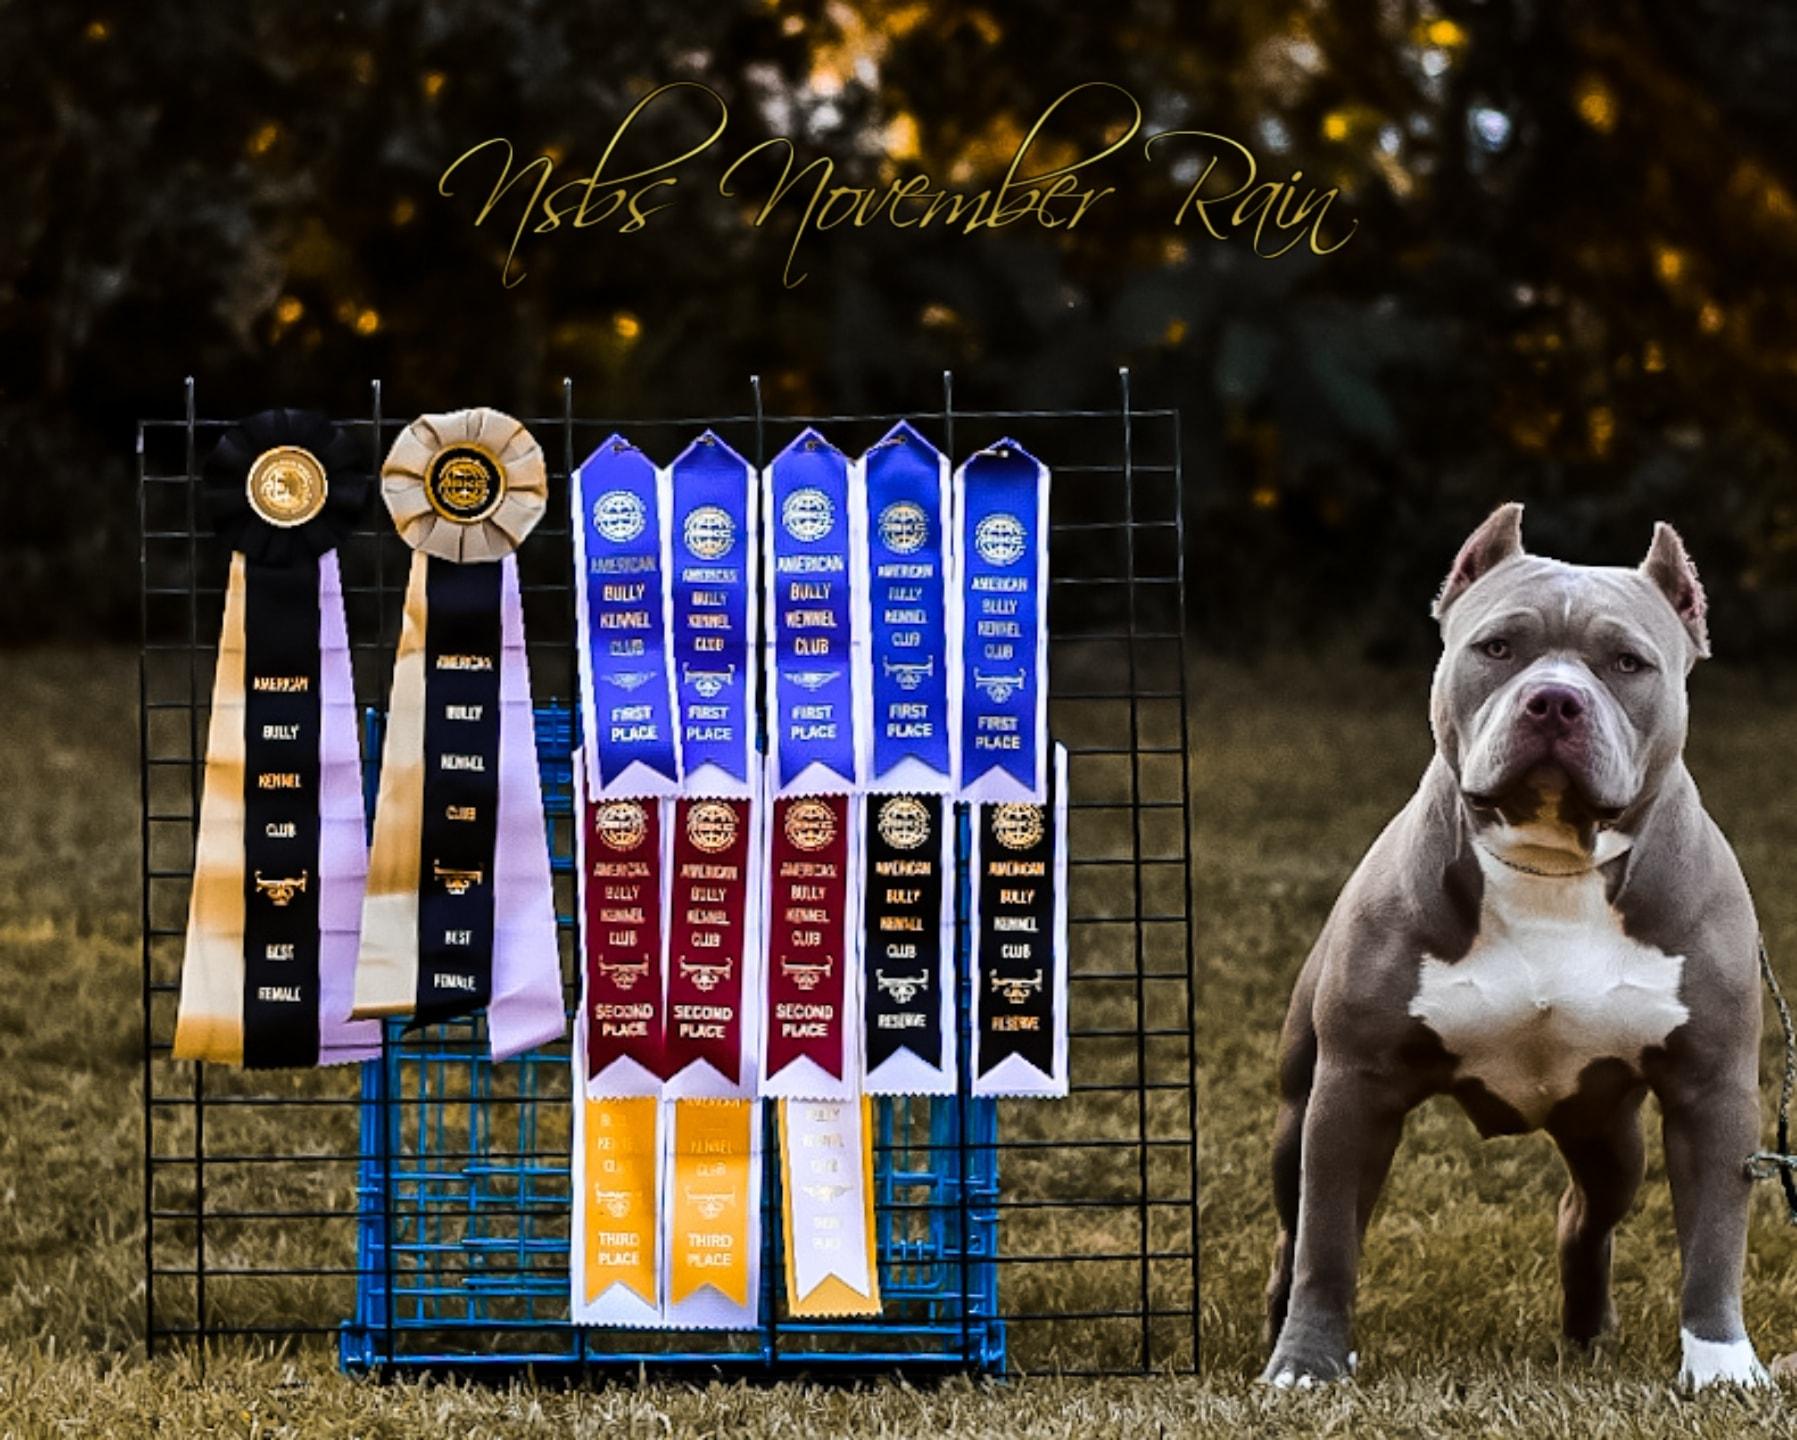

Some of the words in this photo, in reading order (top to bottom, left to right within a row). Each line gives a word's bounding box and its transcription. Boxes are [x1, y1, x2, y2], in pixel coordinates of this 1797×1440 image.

[776, 555, 844, 572] AMERICAN
[878, 564, 933, 577] AMERICAN
[603, 583, 645, 601] BULLY
[791, 583, 832, 600] BULLY
[971, 577, 1028, 592] AMERICAN
[692, 591, 727, 606] BULLY
[982, 600, 1018, 615] BULLY
[600, 612, 651, 629] KENNEL
[786, 610, 838, 627] KENNEL
[885, 610, 928, 624] KENNEL
[978, 622, 1022, 637] KENNEL
[795, 638, 829, 656] CLUB
[892, 632, 920, 647] CLUB
[610, 639, 644, 657] CLUB
[985, 645, 1013, 660] CLUB
[446, 705, 482, 721] BULLY
[612, 705, 653, 722] FIRST
[688, 706, 729, 719] FIRST
[792, 705, 832, 719] FIRST
[889, 704, 929, 719] FIRST
[887, 723, 932, 737] PLACE
[978, 717, 1017, 731] FIRST
[263, 725, 299, 740] BULLY
[611, 726, 657, 742] PLACE
[687, 727, 732, 741] PLACE
[791, 725, 837, 739] PLACE
[976, 736, 1020, 749] PLACE
[441, 755, 484, 771] KENNEL
[259, 774, 301, 789] KENNEL
[447, 806, 476, 821] CLUB
[266, 823, 296, 838] CLUB
[605, 886, 640, 900] BULLY
[691, 887, 726, 902] BULLY
[791, 885, 826, 900] BULLY
[886, 889, 922, 904] BULLY
[1001, 890, 1035, 904] BULLY
[600, 908, 645, 923] KENNEL
[786, 909, 830, 923] KENNEL
[446, 930, 471, 945] BEST
[609, 931, 637, 946] CLUB
[691, 933, 720, 947] CLUB
[792, 931, 821, 946] CLUB
[266, 945, 293, 960] BEST
[887, 945, 916, 958] CLUB
[1002, 944, 1030, 958] CLUB
[596, 1003, 653, 1020] SECOND
[674, 1005, 732, 1020] SECOND
[776, 1003, 833, 1019] SECOND
[878, 1014, 926, 1028] RESERVE
[602, 1022, 648, 1036] PLACE
[680, 1024, 726, 1038] PLACE
[782, 1023, 828, 1038] PLACE
[598, 1232, 640, 1246] THIRD
[688, 1233, 733, 1248] THIRD
[598, 1252, 640, 1266] PLACE
[687, 1253, 731, 1267] PLACE
